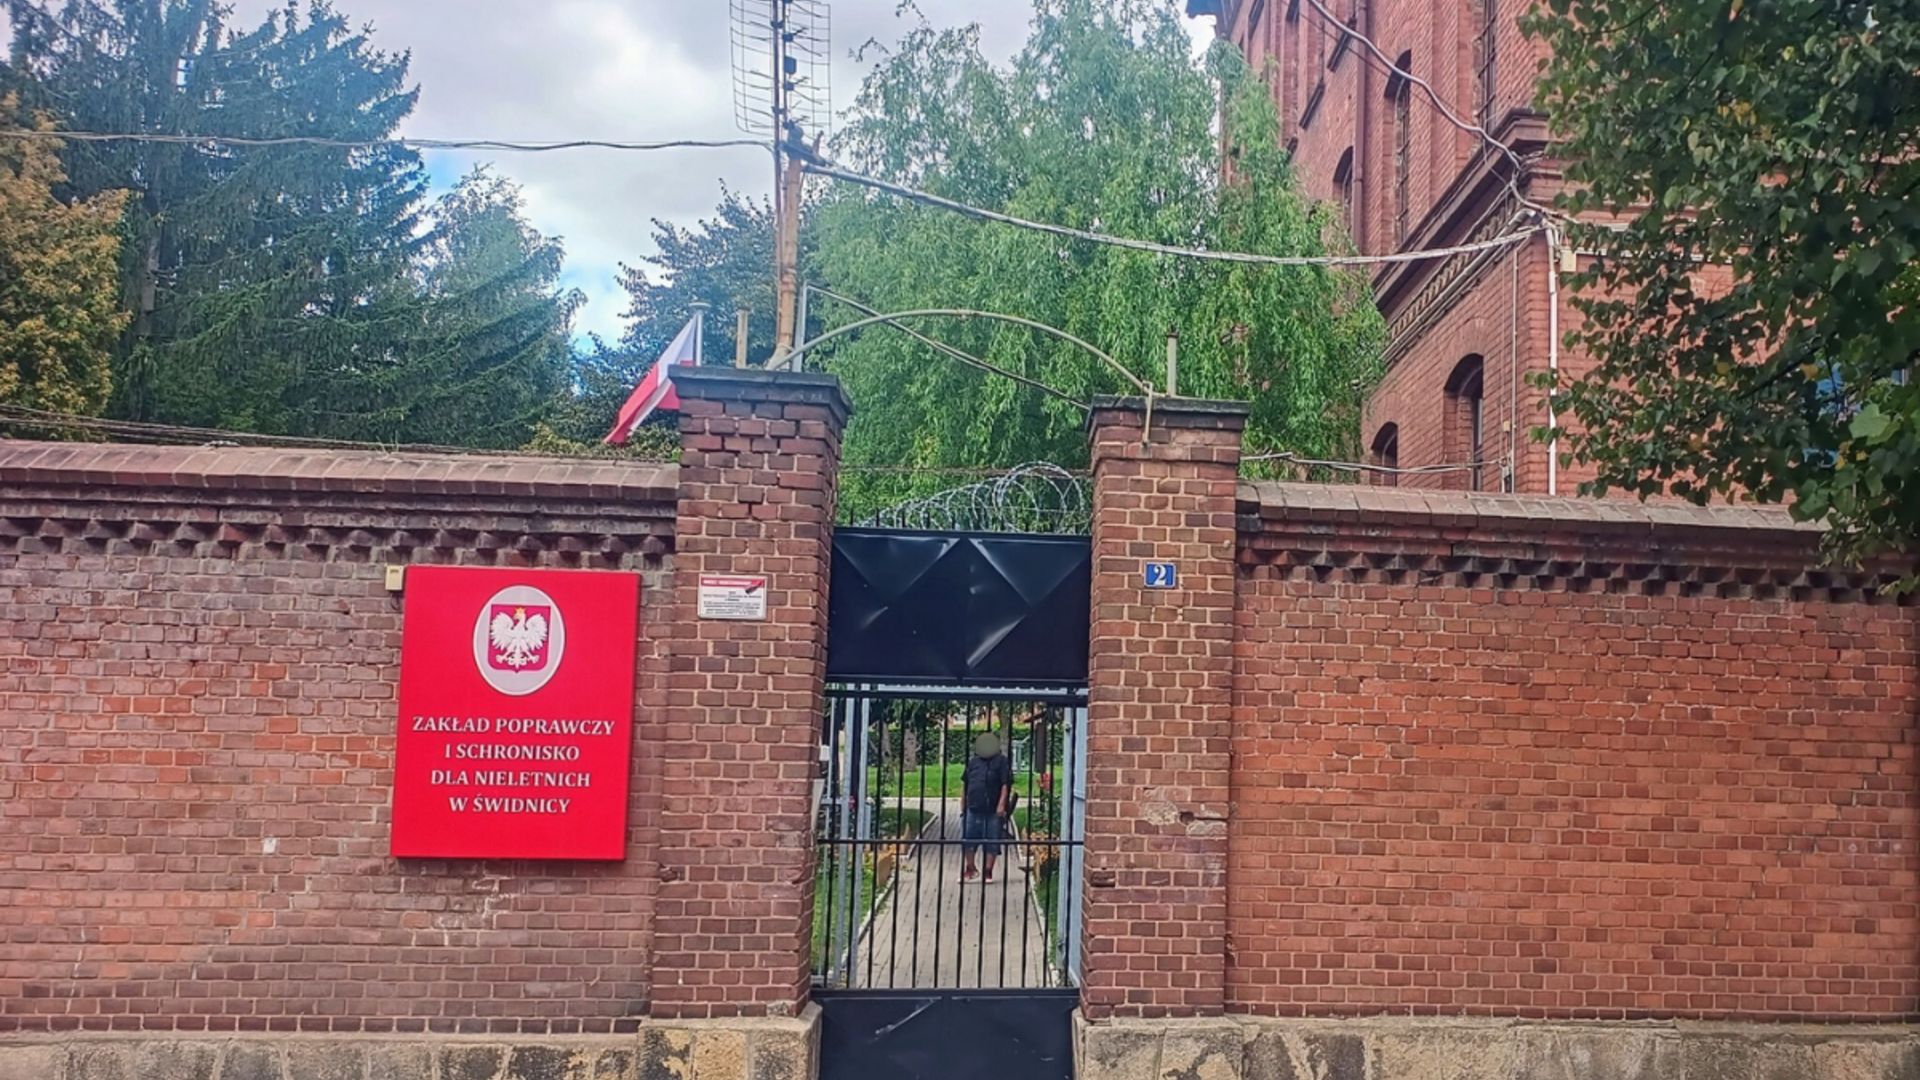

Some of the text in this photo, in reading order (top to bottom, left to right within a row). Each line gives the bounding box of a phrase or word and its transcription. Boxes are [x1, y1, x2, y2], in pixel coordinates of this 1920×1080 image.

[1153, 565, 1167, 586] 2
[412, 717, 615, 735] ZAKŁAD POPRAWCZY
[445, 744, 580, 761] I SCHRONISKO
[431, 770, 590, 787] DLA NIELETNICH
[449, 793, 570, 813] W ŚWIDNICY
